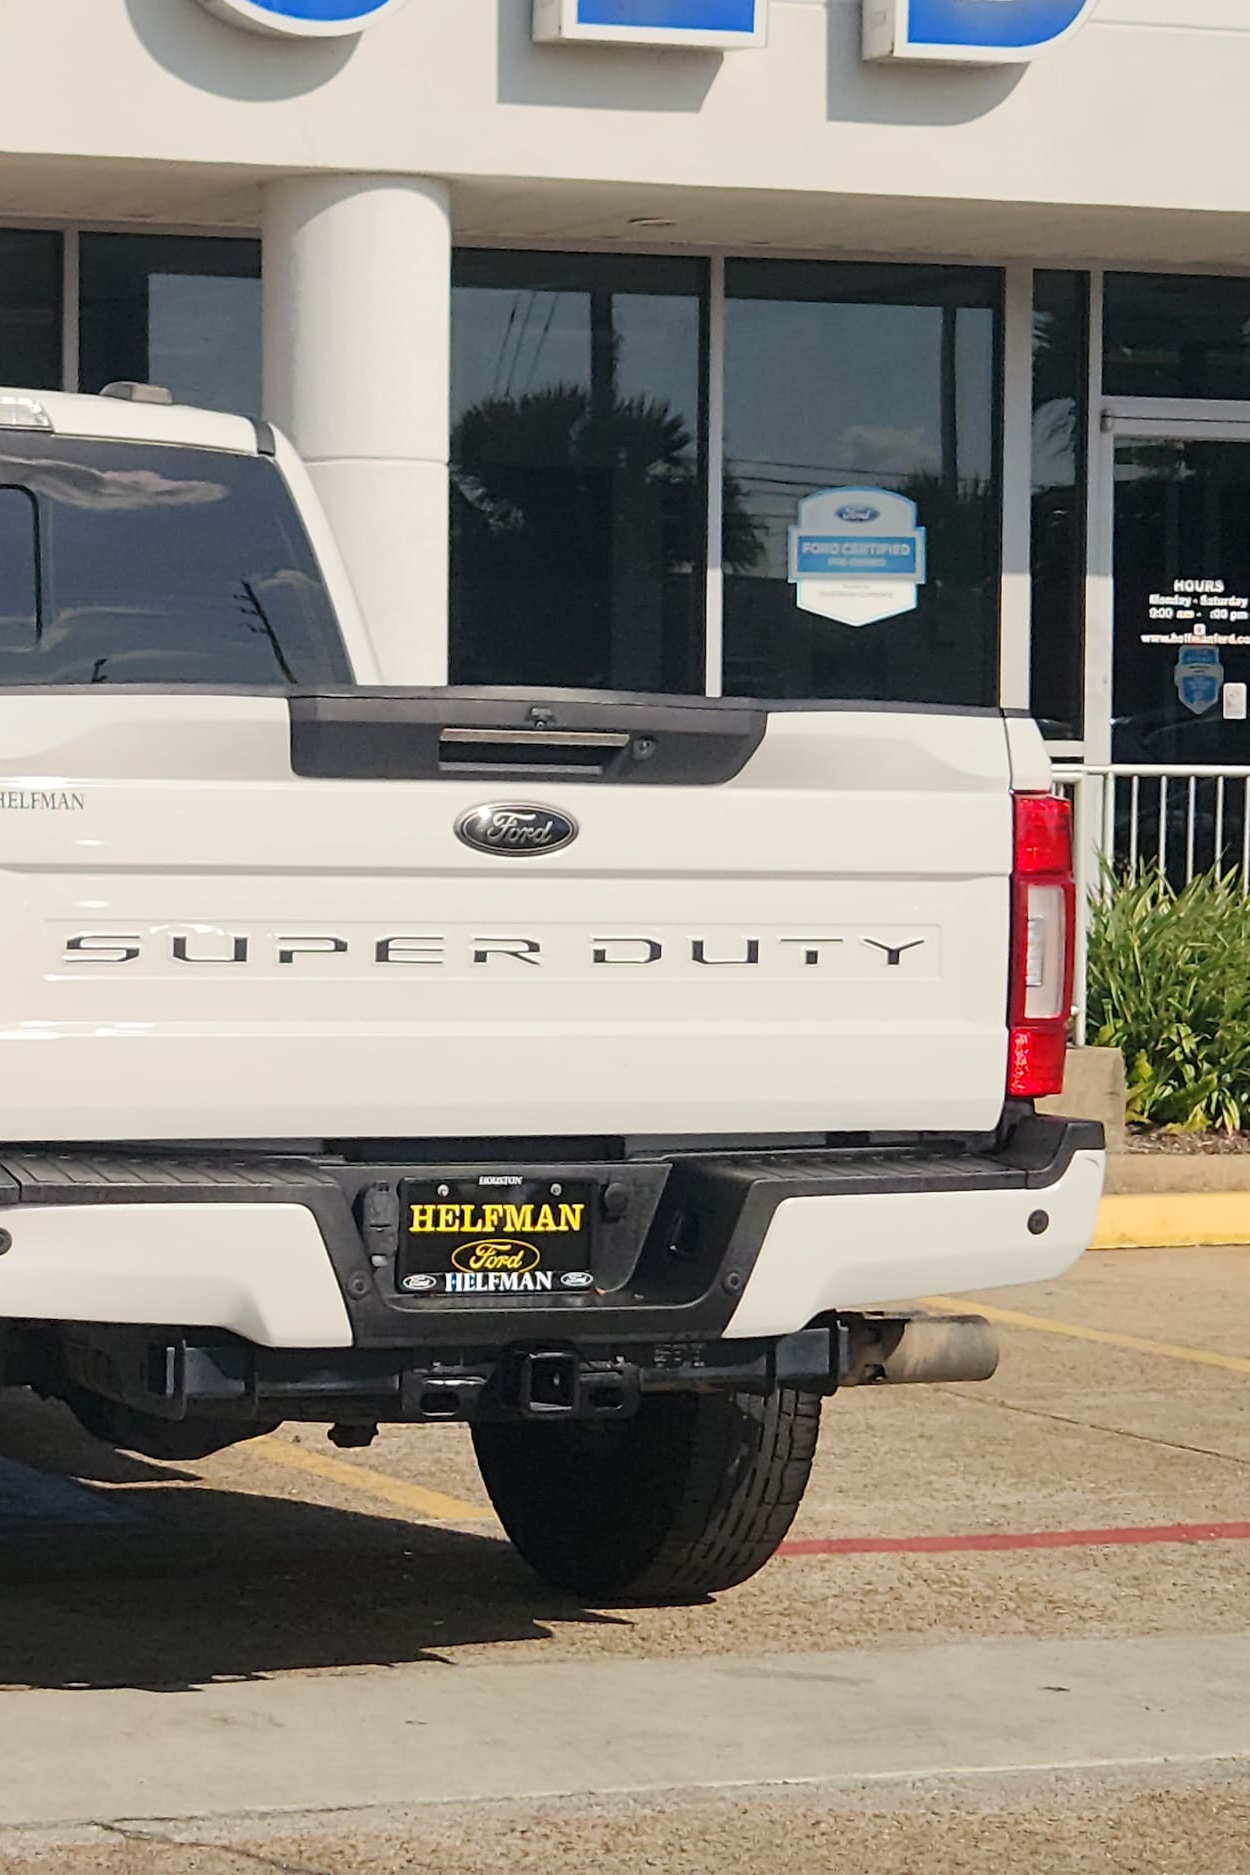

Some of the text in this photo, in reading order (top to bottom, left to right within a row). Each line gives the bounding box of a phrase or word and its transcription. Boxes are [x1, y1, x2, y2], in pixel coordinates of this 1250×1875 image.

[1173, 579, 1225, 593] HOURS
[1200, 594, 1249, 608] Saturday
[486, 811, 554, 843] Ford
[61, 935, 925, 966] SUPER DUTY
[479, 1176, 524, 1186] HOUSTON
[409, 1204, 585, 1232] HELFMAN
[469, 1243, 525, 1270] Ford
[445, 1271, 553, 1292] HELFMAN
